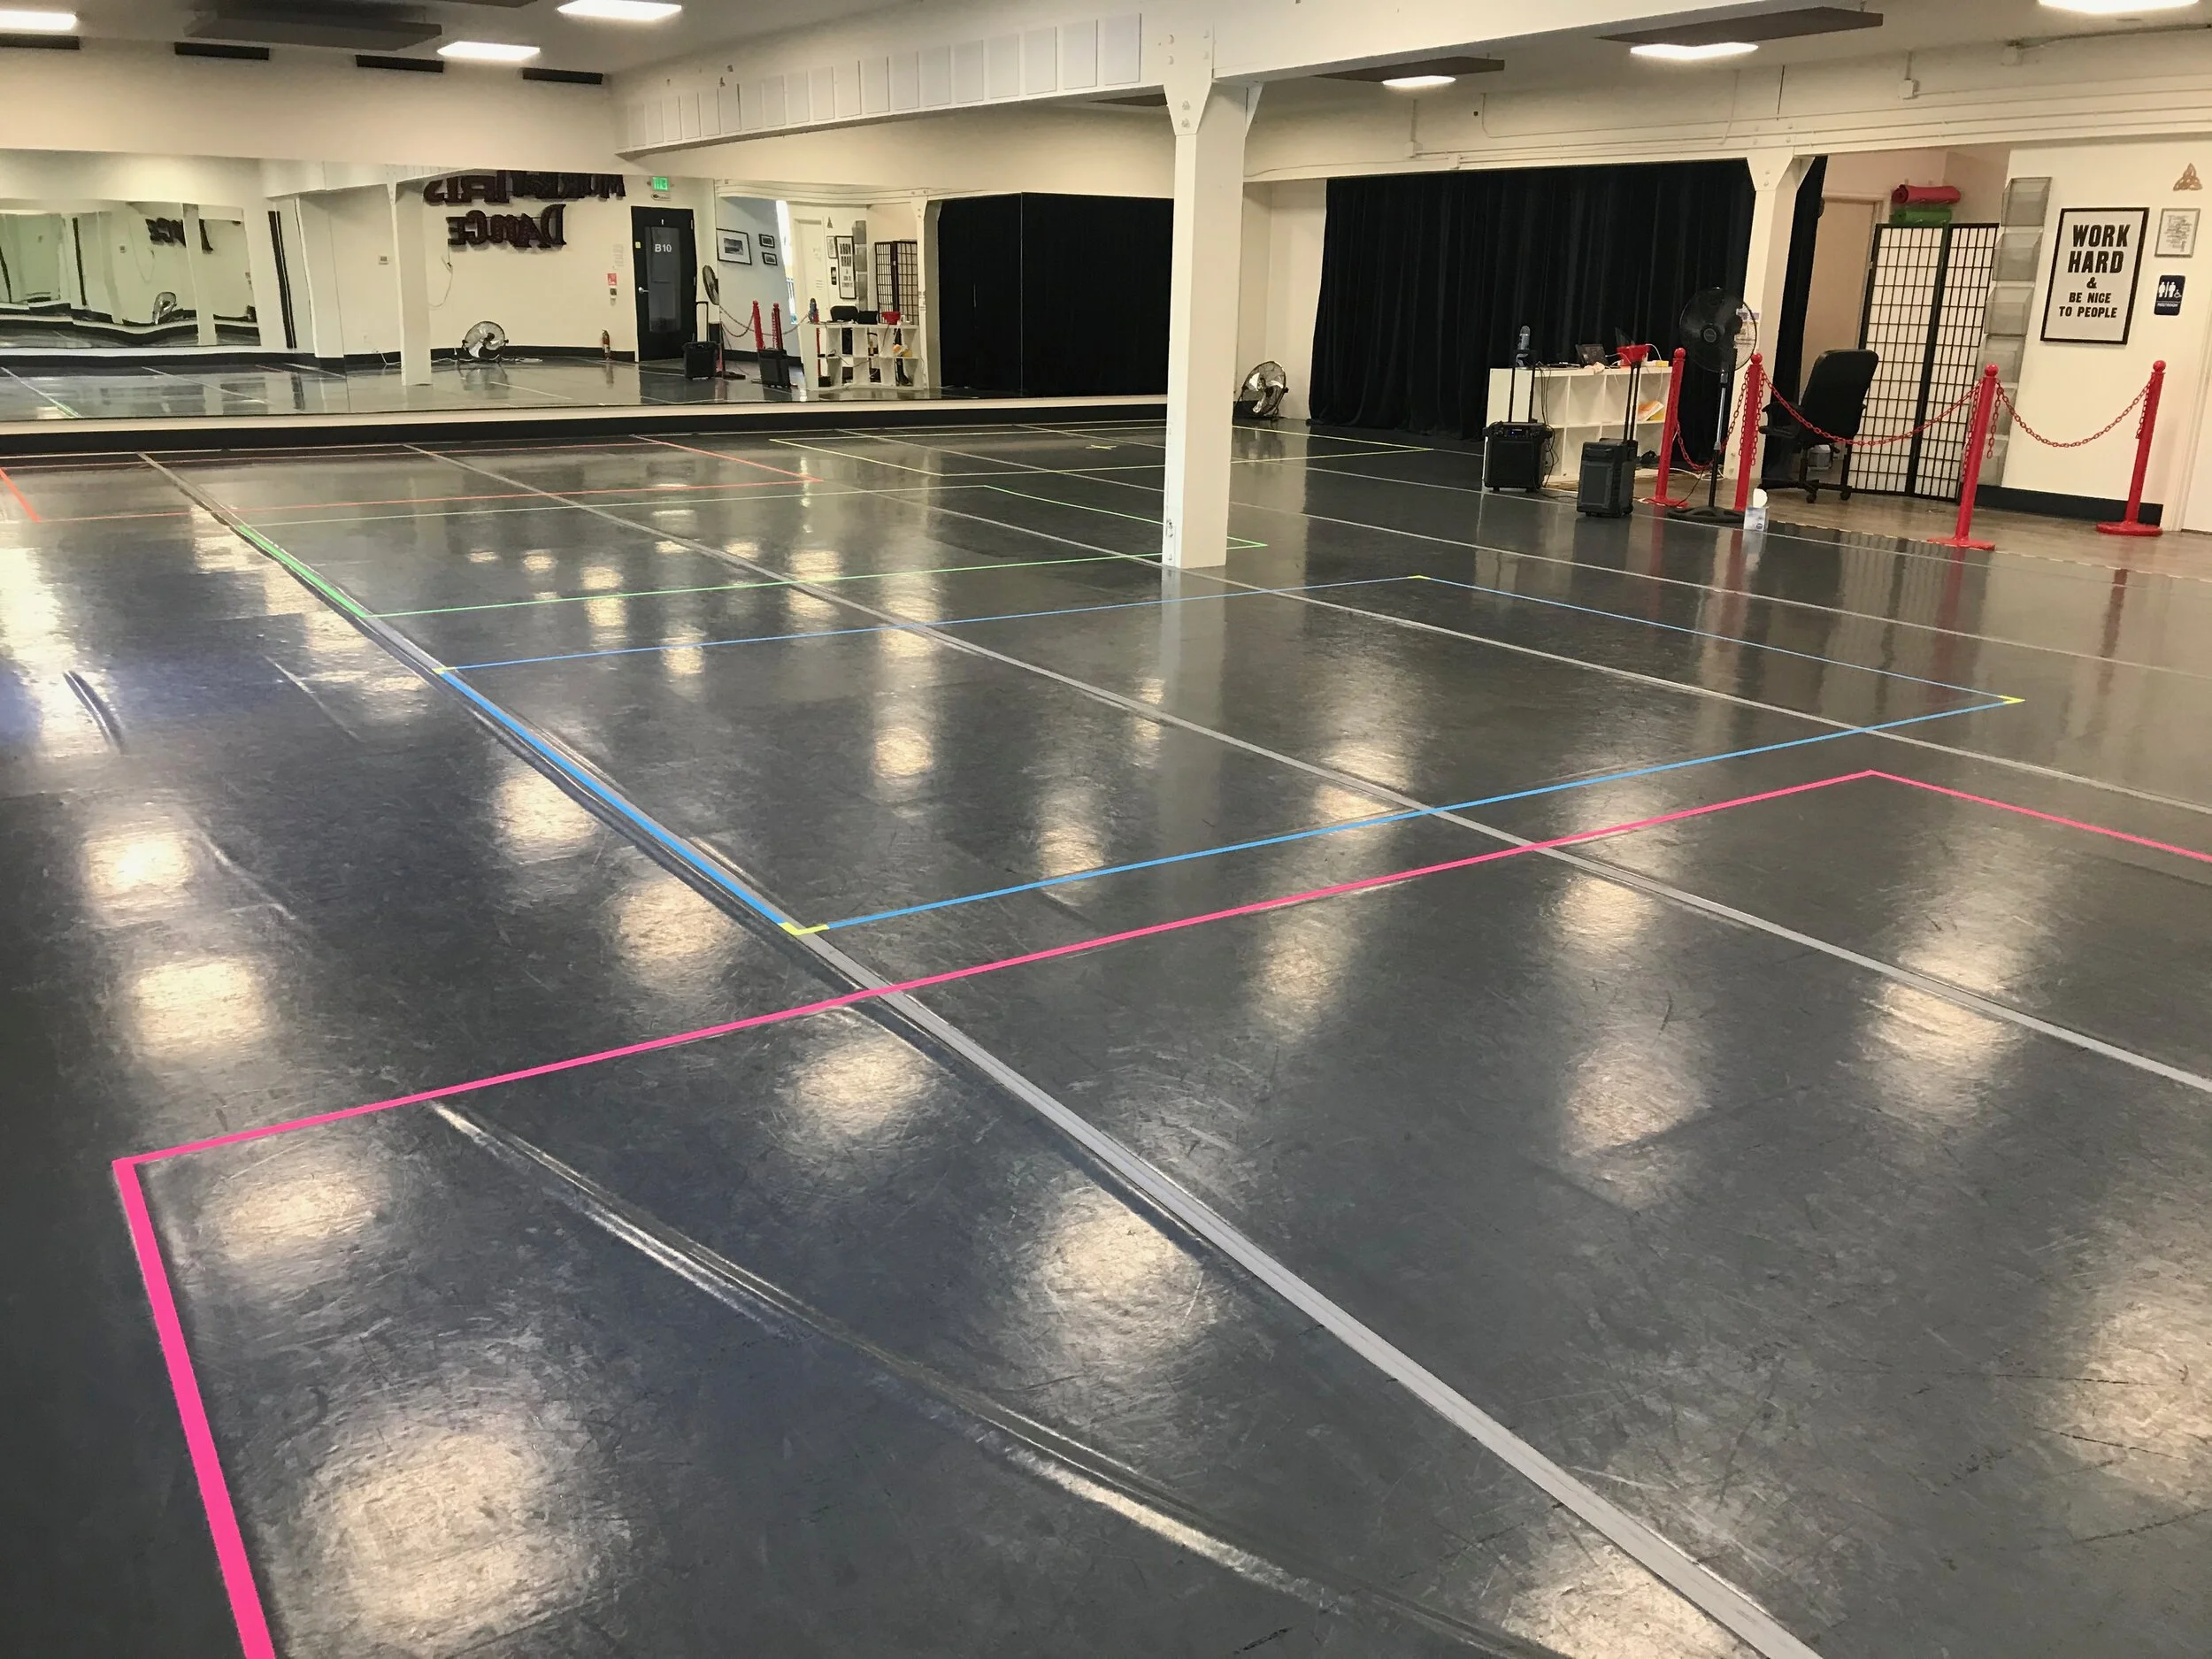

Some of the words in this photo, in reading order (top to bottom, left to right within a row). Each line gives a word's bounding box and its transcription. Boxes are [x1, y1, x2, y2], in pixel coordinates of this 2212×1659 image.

[2073, 224, 2131, 247] WORK
[655, 243, 672, 252] B10
[2068, 250, 2124, 273] HARD
[2086, 277, 2097, 288] &
[2069, 292, 2082, 303] BE
[2087, 293, 2111, 303] NICE
[2059, 306, 2072, 317] TO
[2077, 306, 2117, 318] PEOPLE
